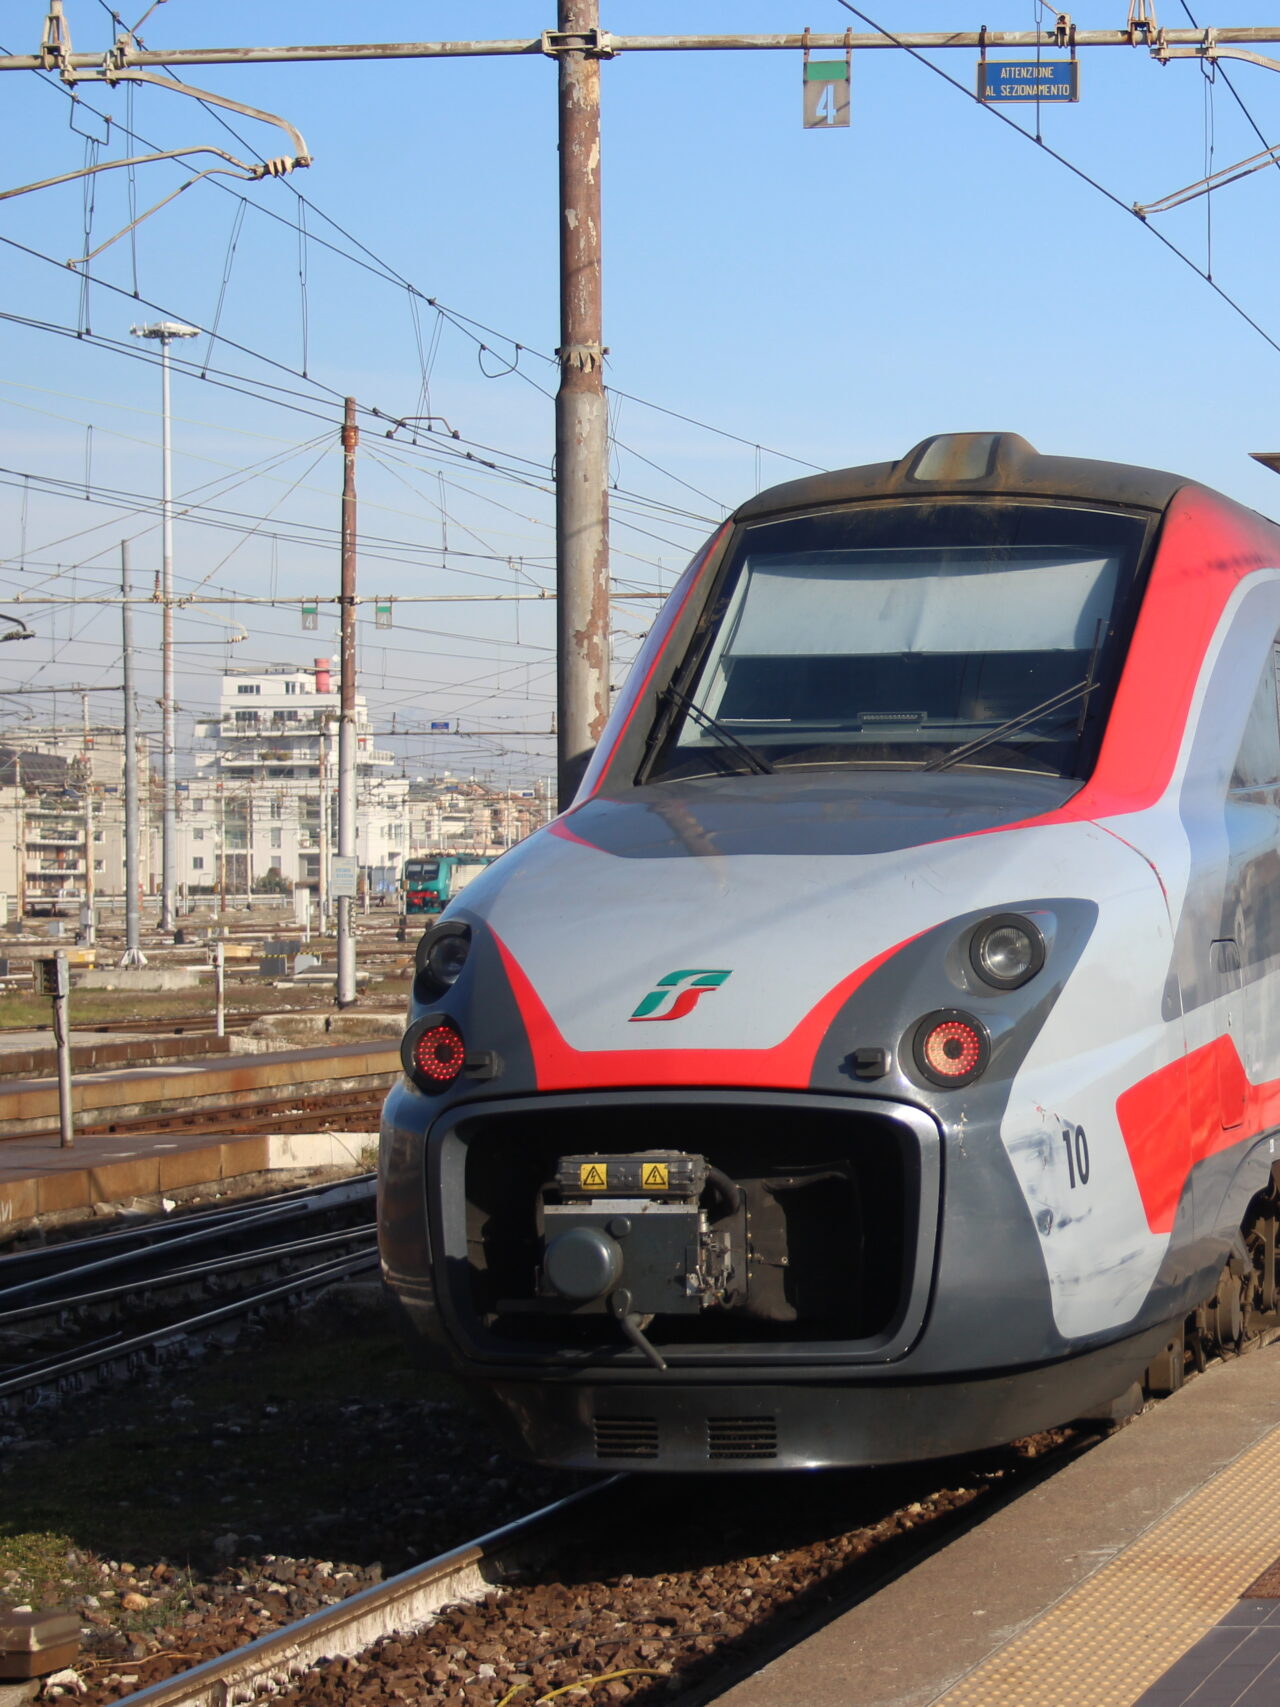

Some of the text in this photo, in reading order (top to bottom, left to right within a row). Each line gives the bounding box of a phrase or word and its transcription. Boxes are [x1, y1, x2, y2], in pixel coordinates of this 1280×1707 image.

[1000, 66, 1055, 79] ATTENZIONE
[985, 83, 1070, 97] AL SEZIONAMENTO
[815, 84, 837, 125] 4
[306, 616, 314, 630] 4
[1062, 1124, 1090, 1189] 10
